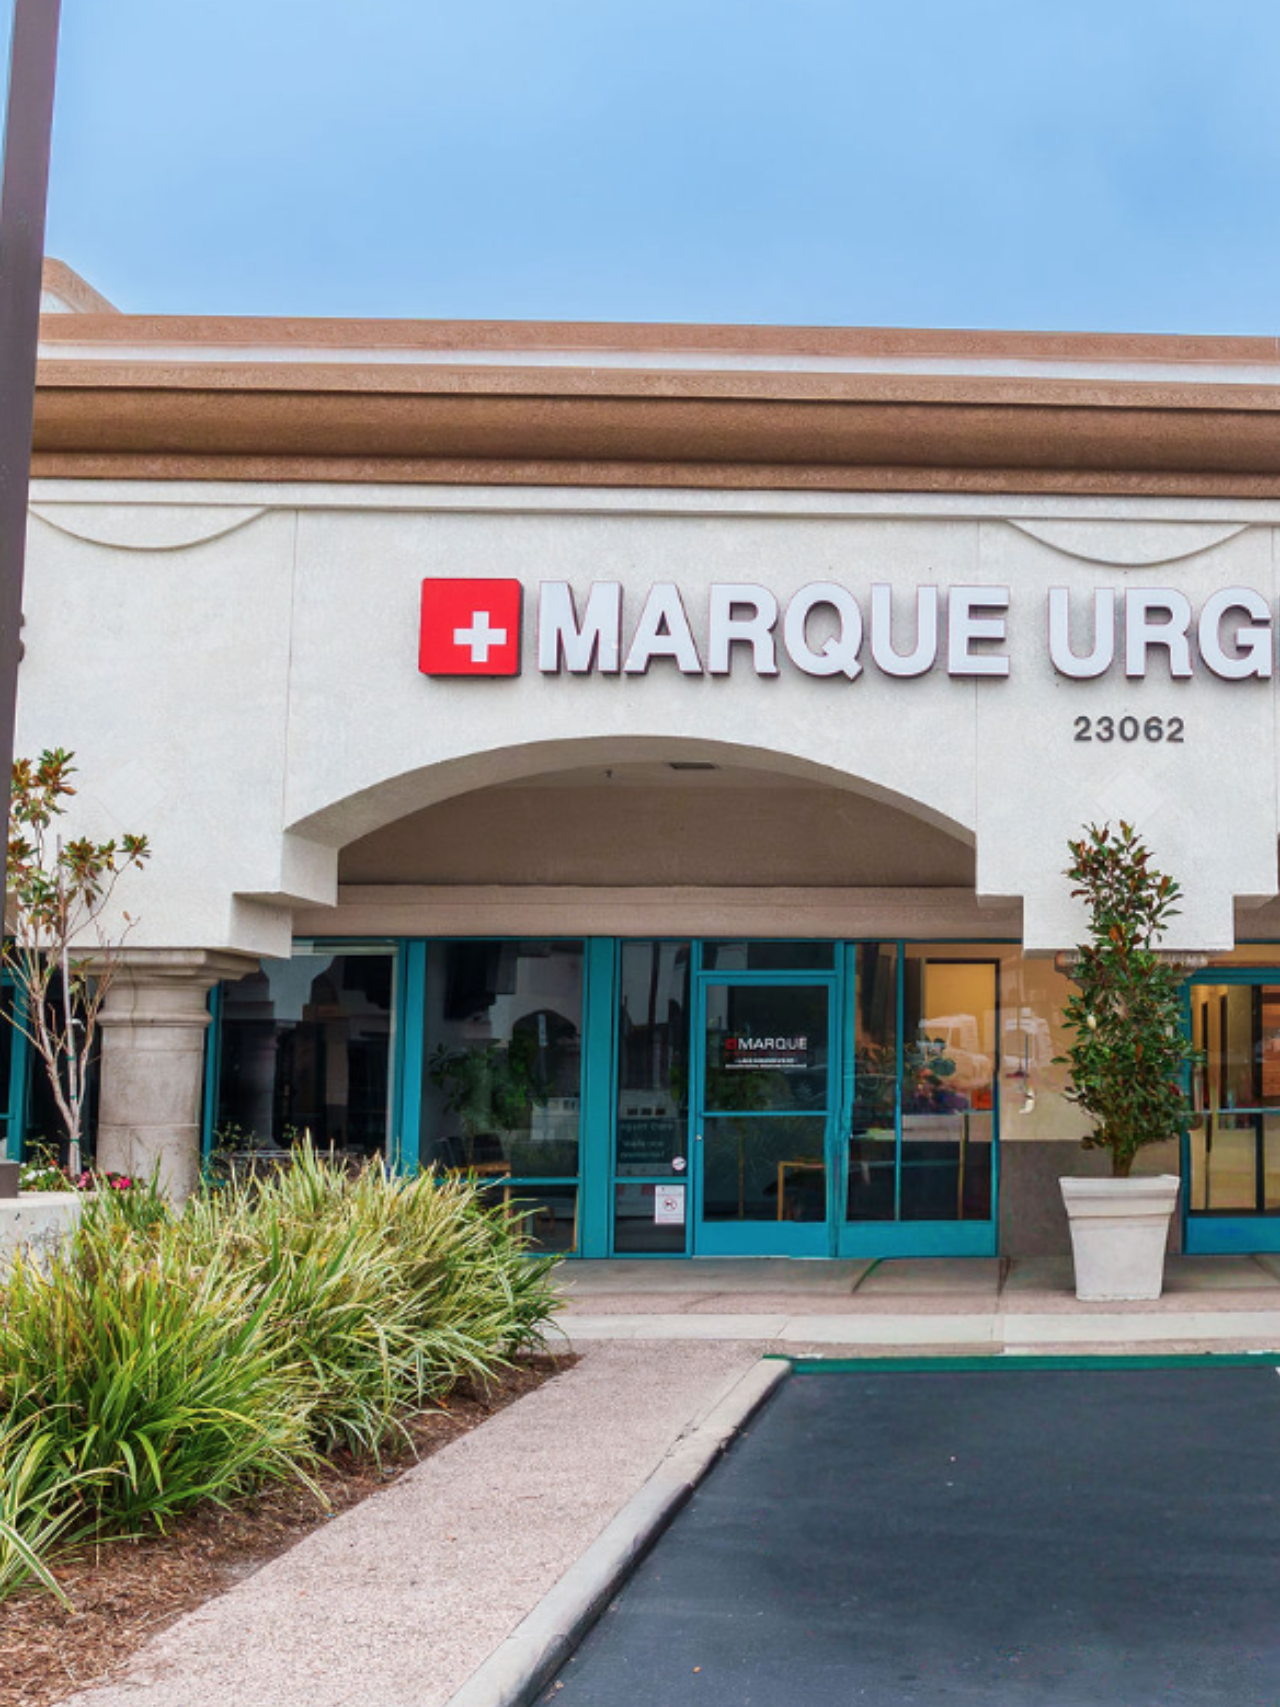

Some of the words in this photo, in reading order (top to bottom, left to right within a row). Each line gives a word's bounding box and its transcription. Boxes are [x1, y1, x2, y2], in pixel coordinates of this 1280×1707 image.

[537, 580, 1010, 682] MARQUE
[1073, 715, 1184, 743] 23062
[738, 1037, 807, 1050] MARQUE
